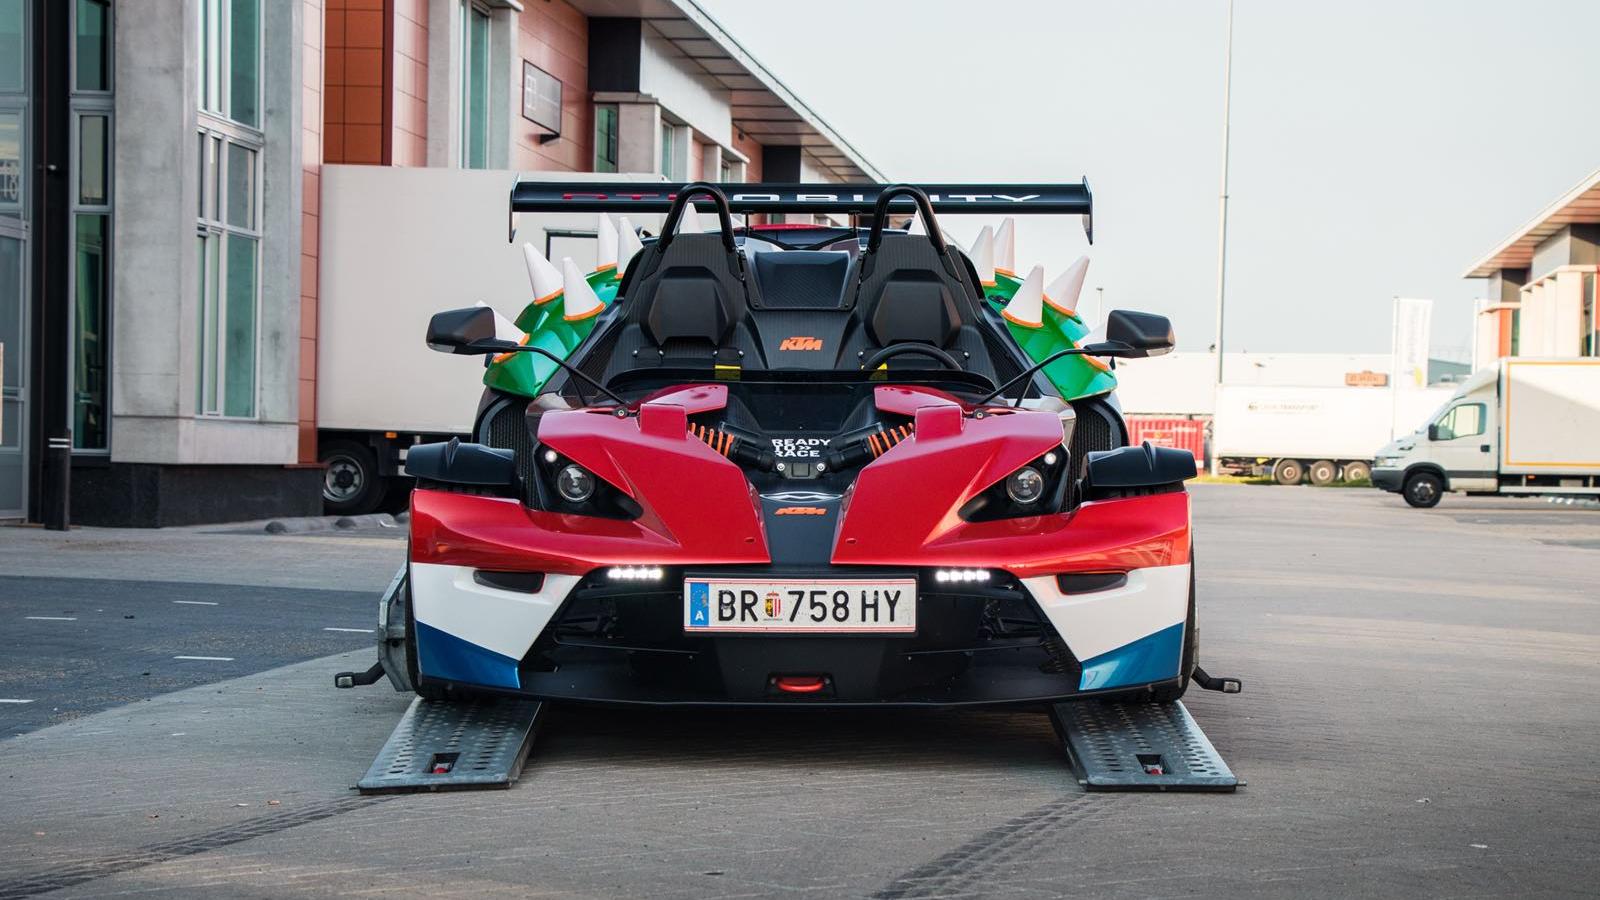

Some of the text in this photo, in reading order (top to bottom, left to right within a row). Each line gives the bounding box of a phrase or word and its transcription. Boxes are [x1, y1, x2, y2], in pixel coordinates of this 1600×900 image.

[780, 336, 823, 351] KTM
[771, 438, 831, 446] READY
[774, 450, 821, 458] RACE
[717, 589, 901, 623] BR 758 HY
[694, 610, 705, 621] A
